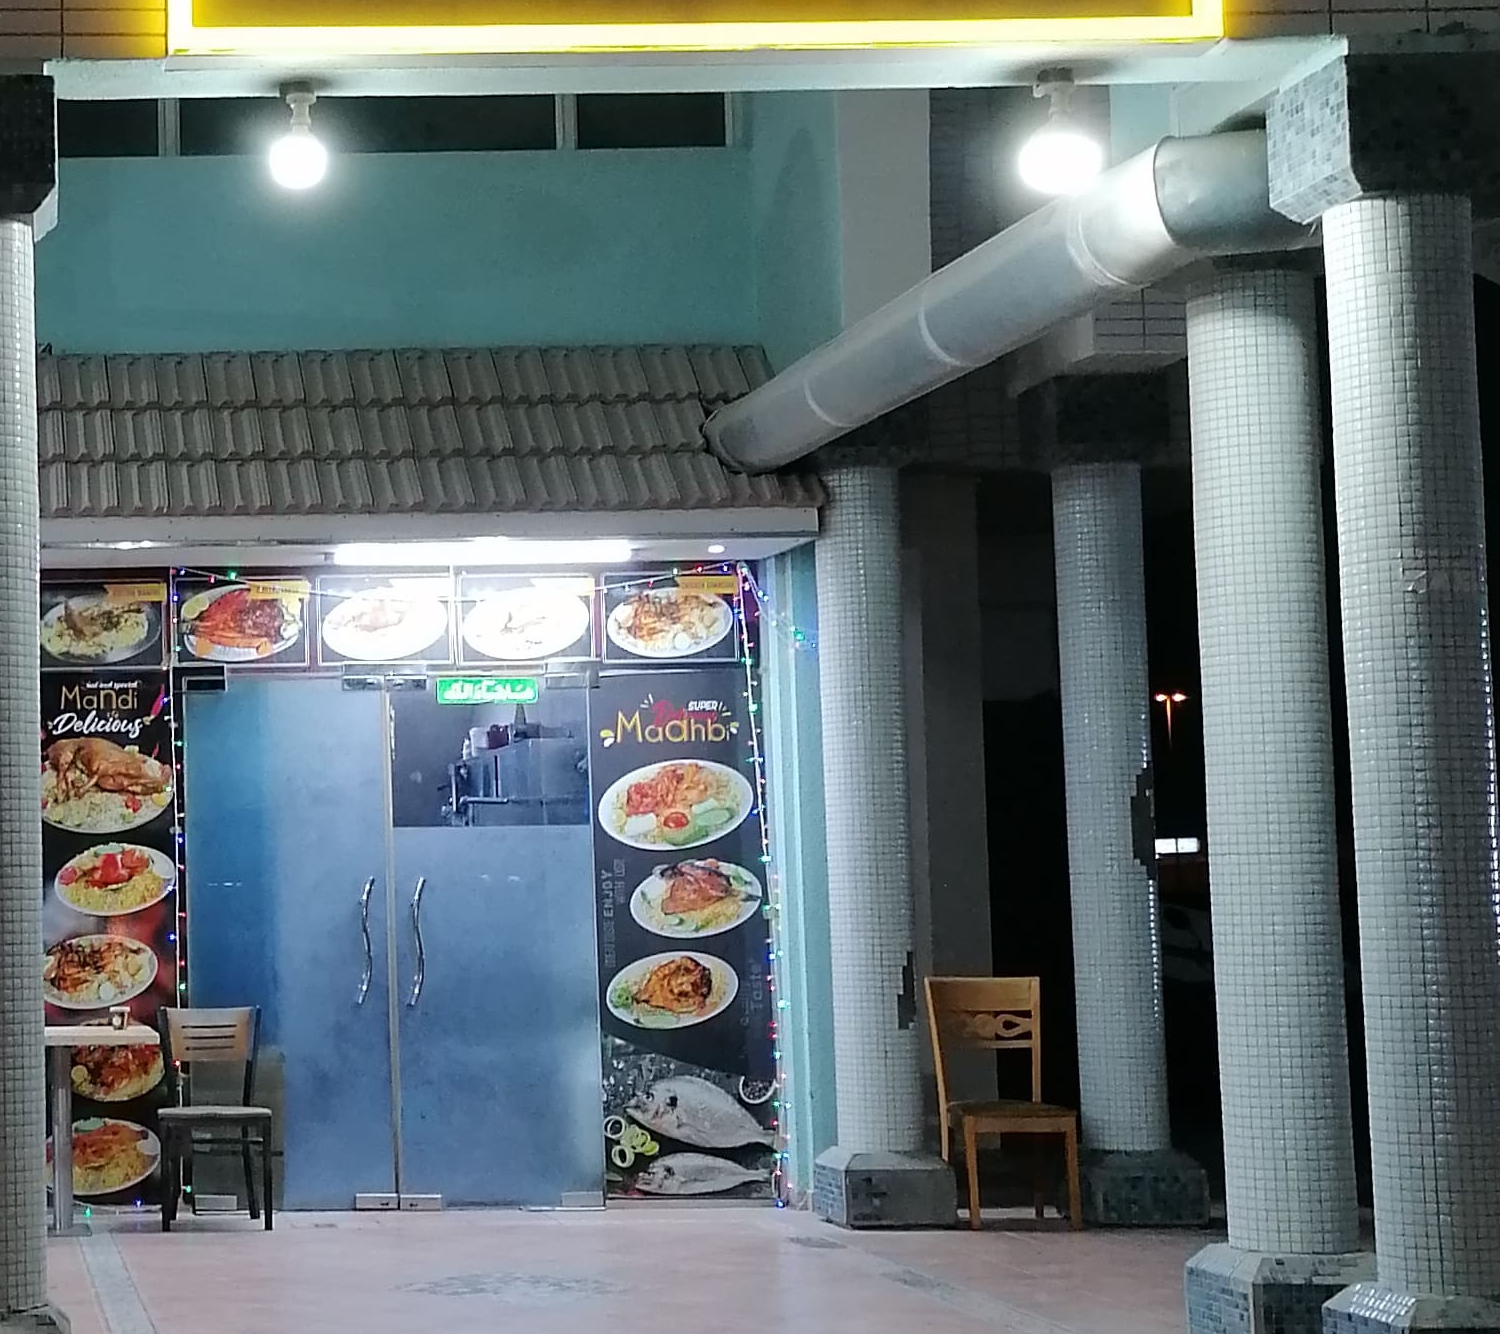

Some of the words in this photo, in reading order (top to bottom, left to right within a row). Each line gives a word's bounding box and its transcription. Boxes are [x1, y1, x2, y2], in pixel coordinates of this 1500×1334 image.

[60, 685, 138, 710] Mandi
[688, 700, 718, 711] SUPER
[52, 710, 143, 739] Delicious
[601, 869, 613, 917] ENJOY
